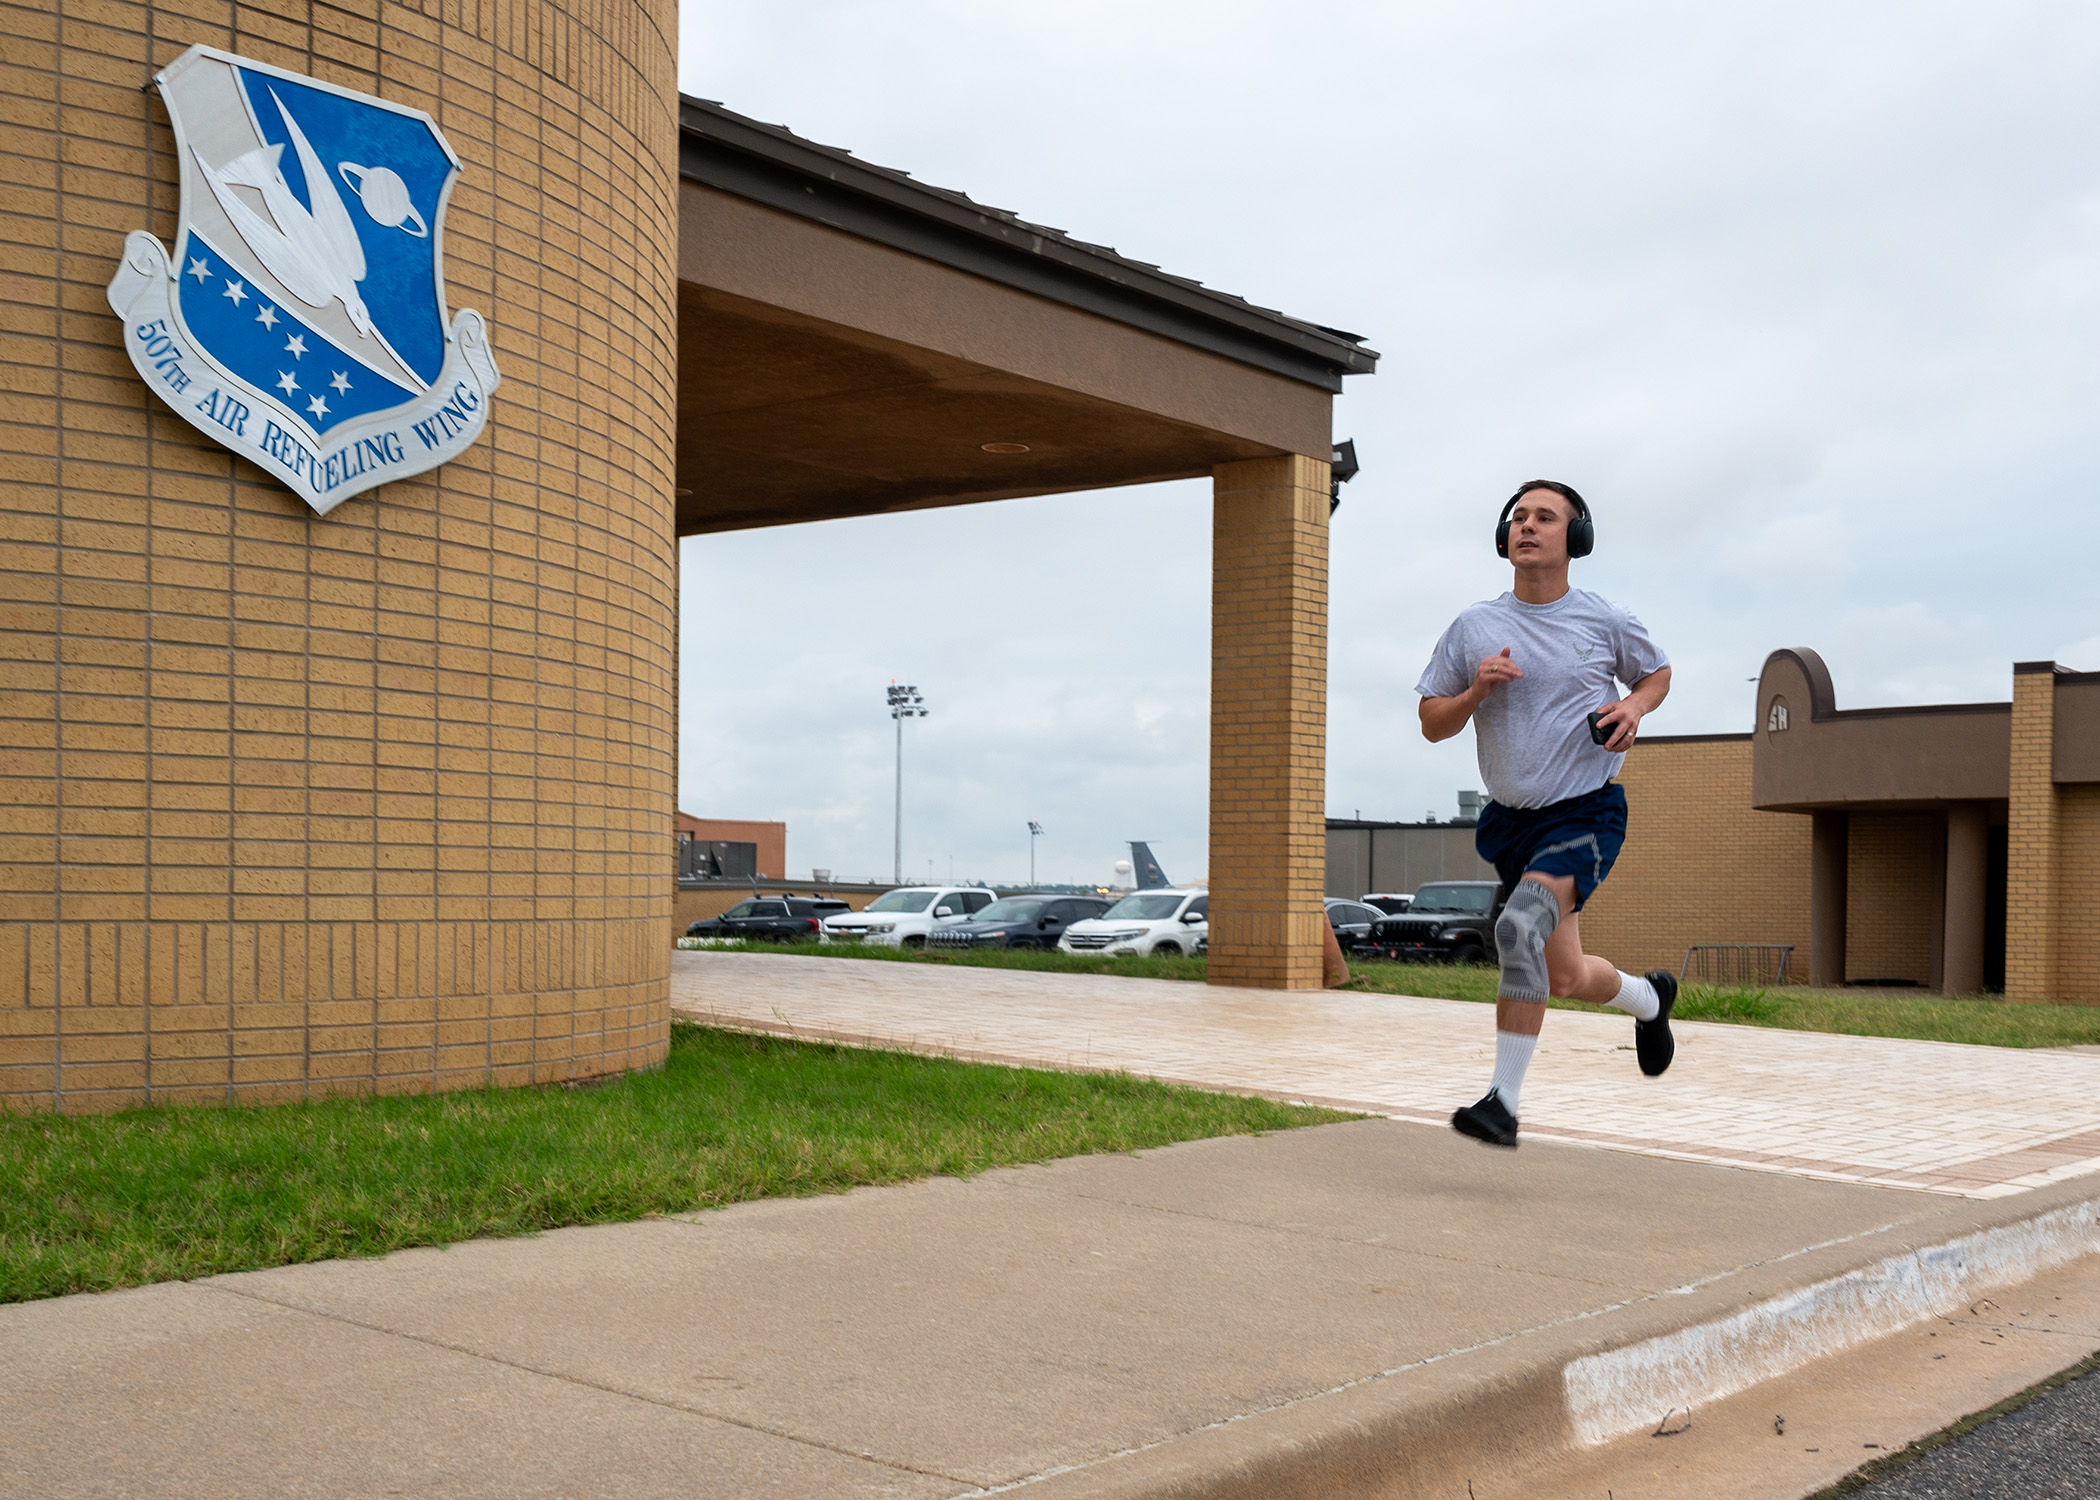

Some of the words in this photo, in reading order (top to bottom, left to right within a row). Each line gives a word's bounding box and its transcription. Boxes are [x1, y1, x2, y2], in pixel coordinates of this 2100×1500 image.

[136, 318, 192, 395] 507TH
[195, 388, 249, 437] AIR
[259, 419, 405, 493] REFUELING
[411, 381, 479, 451] WING
